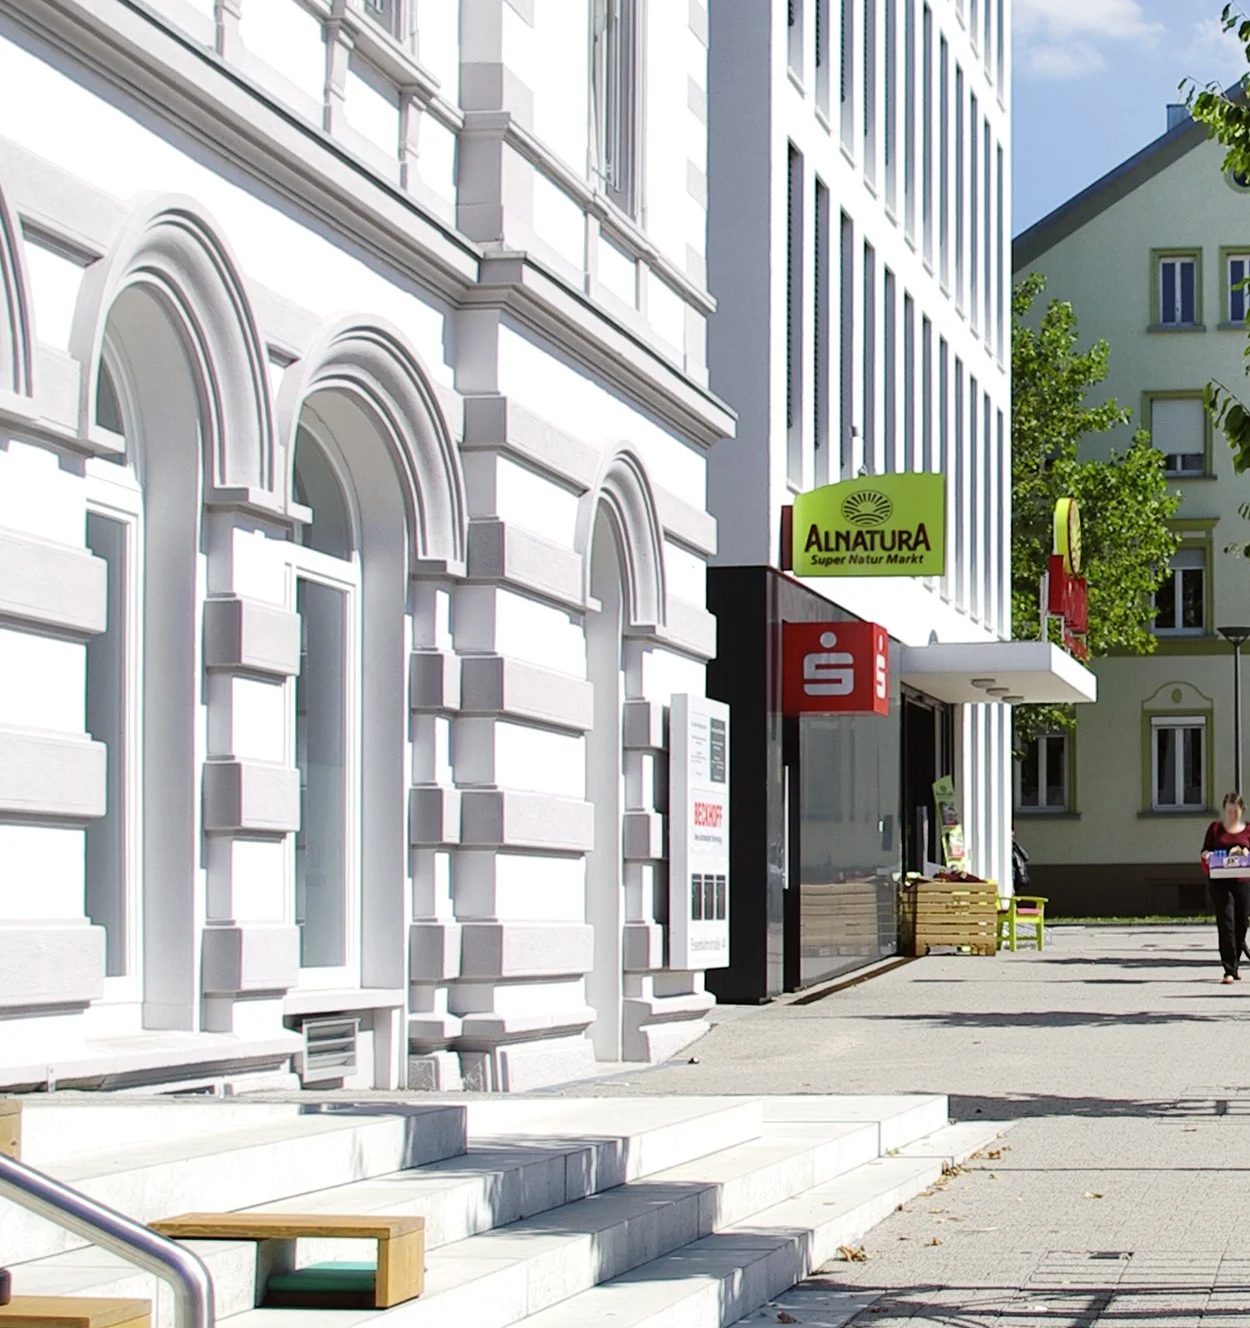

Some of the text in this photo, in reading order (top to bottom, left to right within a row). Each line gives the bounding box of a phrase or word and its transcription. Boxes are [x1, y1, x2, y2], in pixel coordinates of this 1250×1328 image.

[804, 523, 931, 552] ALNATURA
[810, 554, 924, 567] Super Natur Markt
